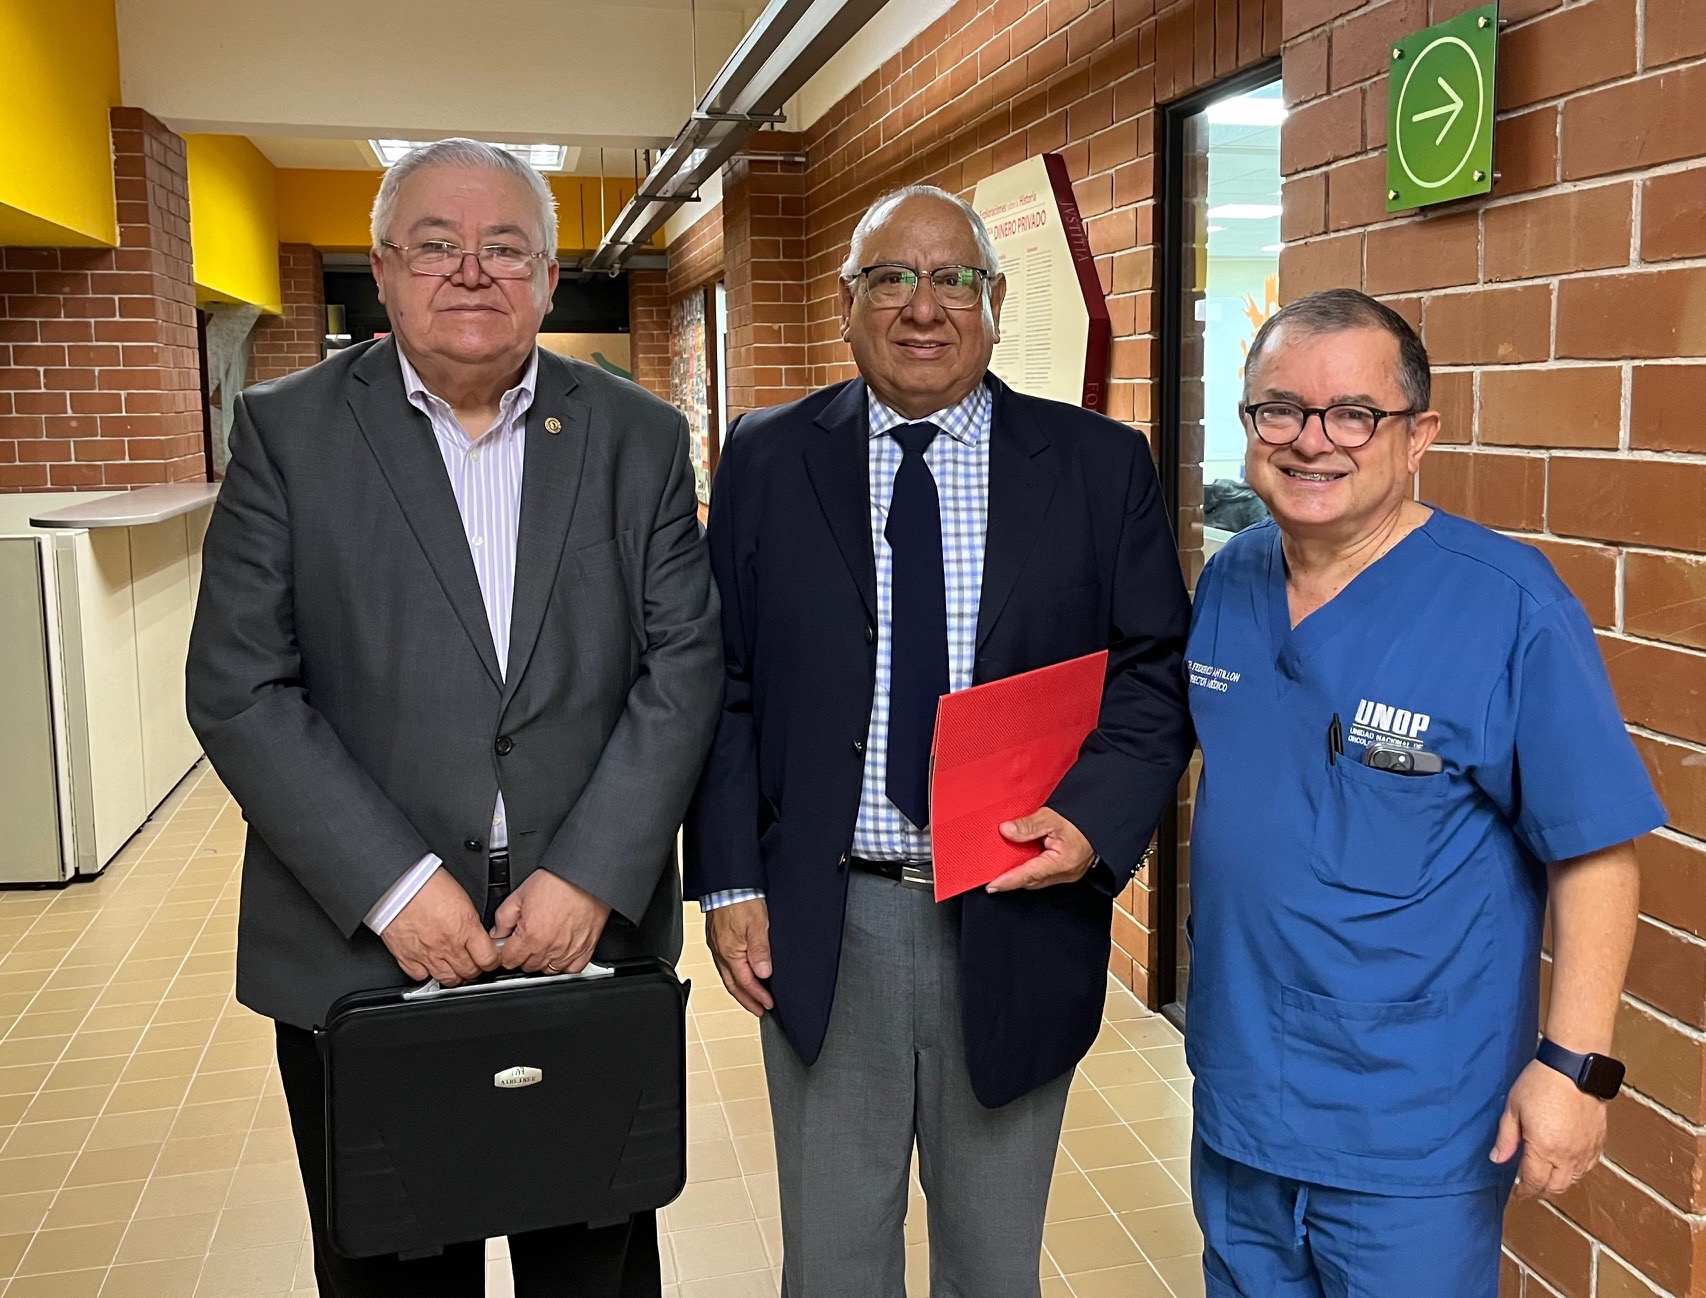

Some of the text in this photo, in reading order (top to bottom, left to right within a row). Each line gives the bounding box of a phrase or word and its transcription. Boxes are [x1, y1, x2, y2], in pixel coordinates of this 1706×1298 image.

[993, 209, 1047, 241] DINERO PRIVADO
[1085, 382, 1099, 411] FO
[1192, 662, 1214, 676] FEDERICO
[1354, 698, 1431, 738] UNOP
[1349, 727, 1375, 739] UNIDAD
